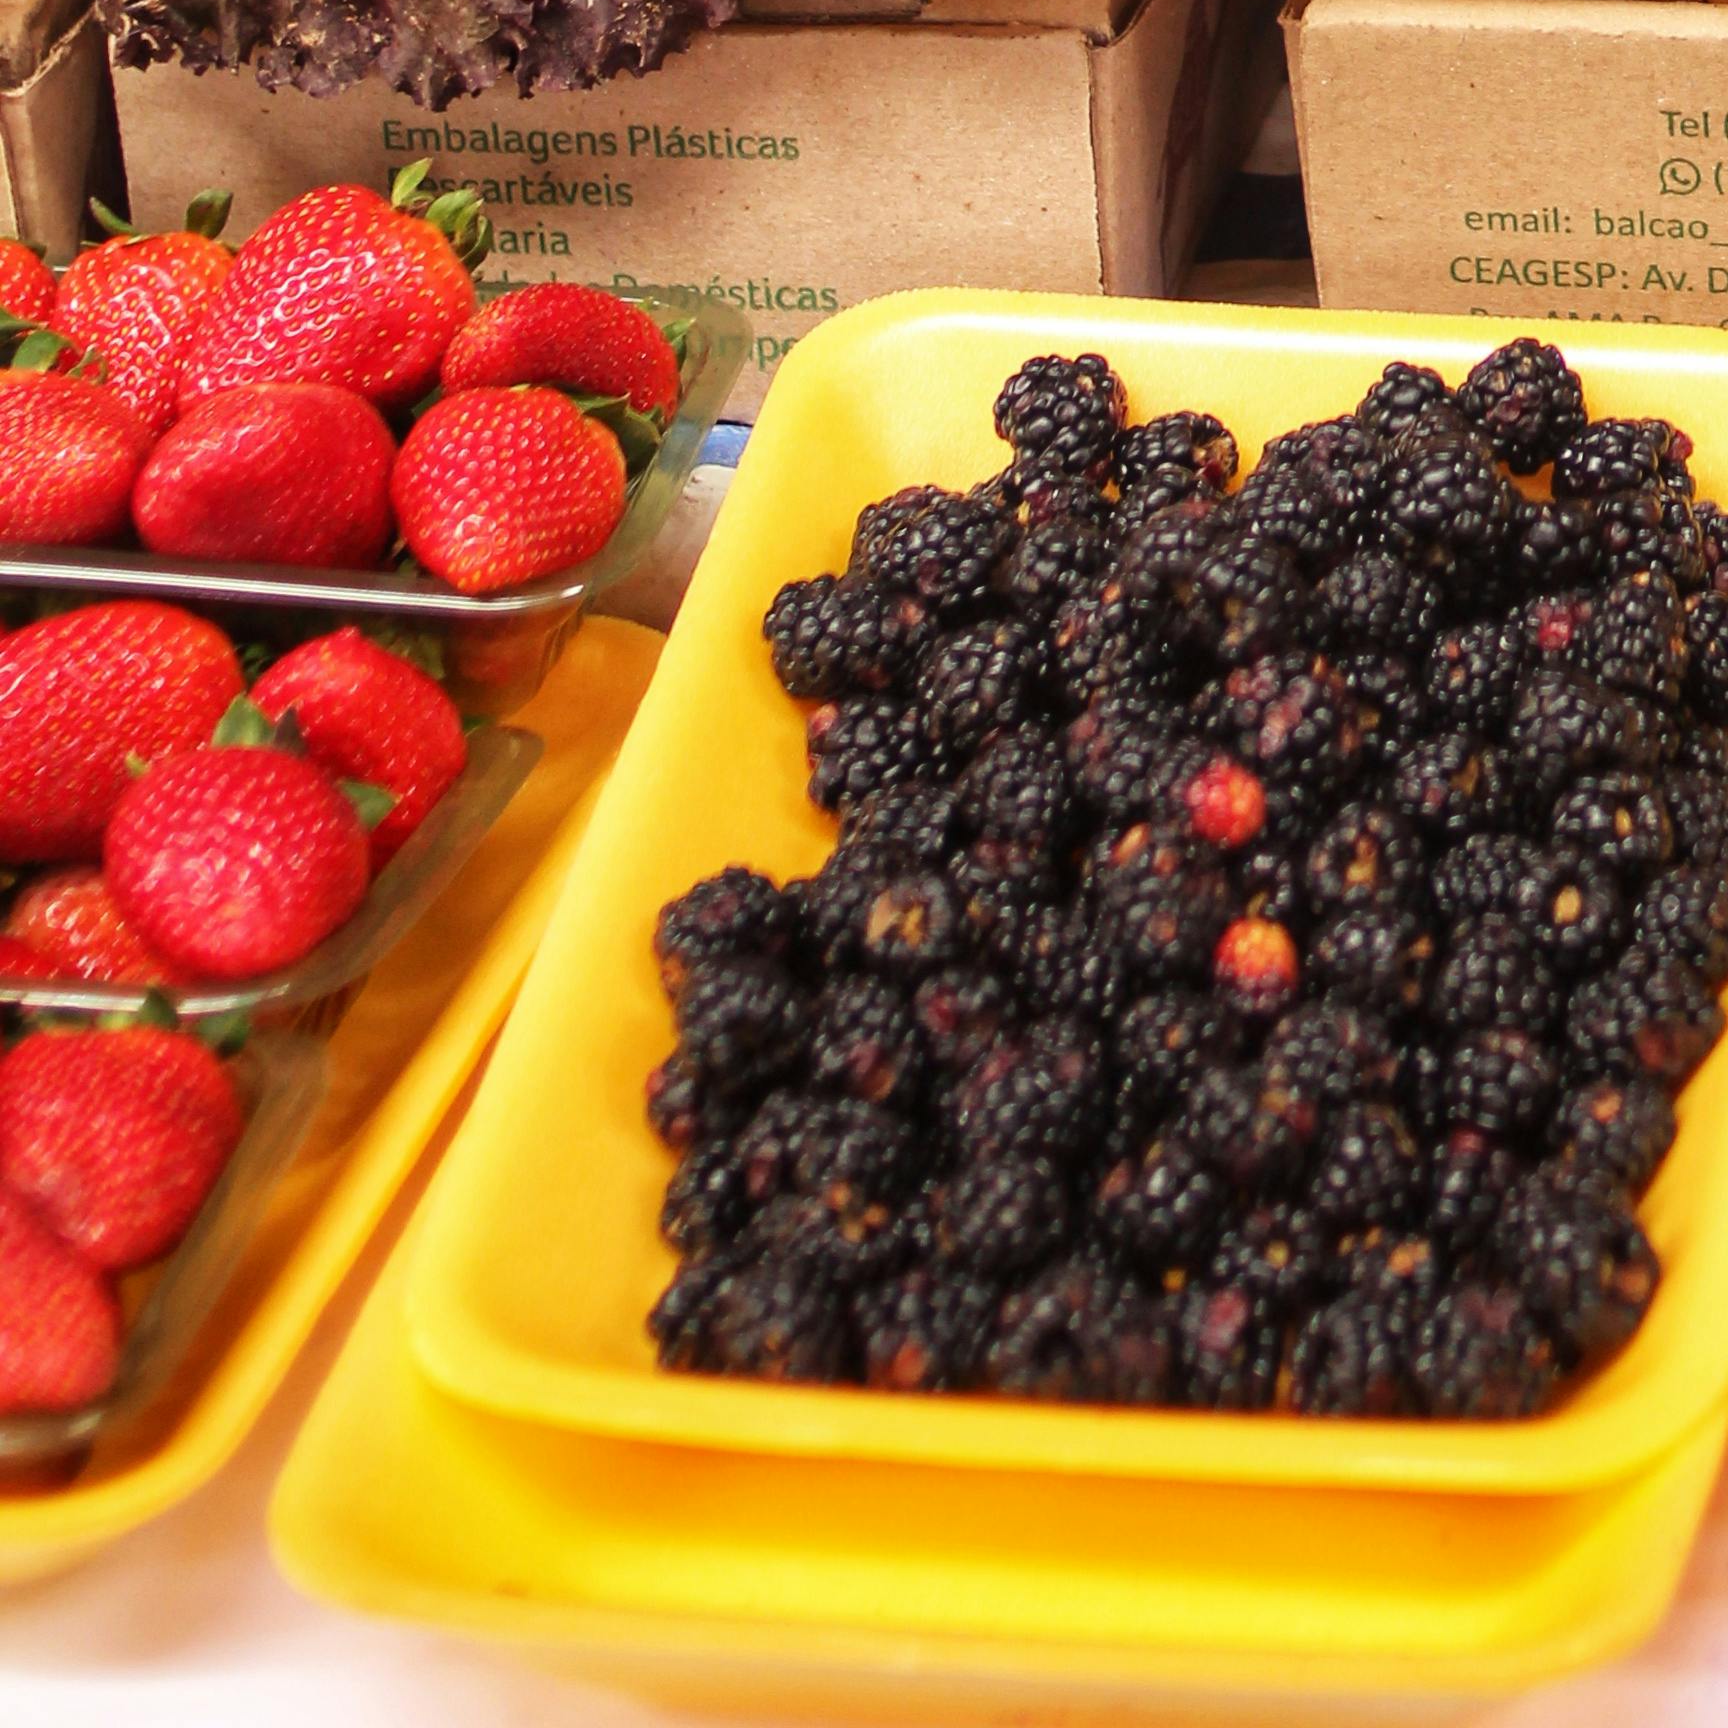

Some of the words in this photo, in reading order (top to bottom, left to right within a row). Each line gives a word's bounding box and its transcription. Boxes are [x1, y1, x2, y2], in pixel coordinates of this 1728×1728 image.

[383, 120, 617, 164] Embalagens
[628, 125, 801, 161] Plásticas
[1659, 110, 1710, 138] Tel
[388, 167, 633, 207] esartáveis
[1464, 208, 1572, 233] email:
[1450, 255, 1629, 290] CEAGESP:
[1642, 264, 1694, 292] Av.
